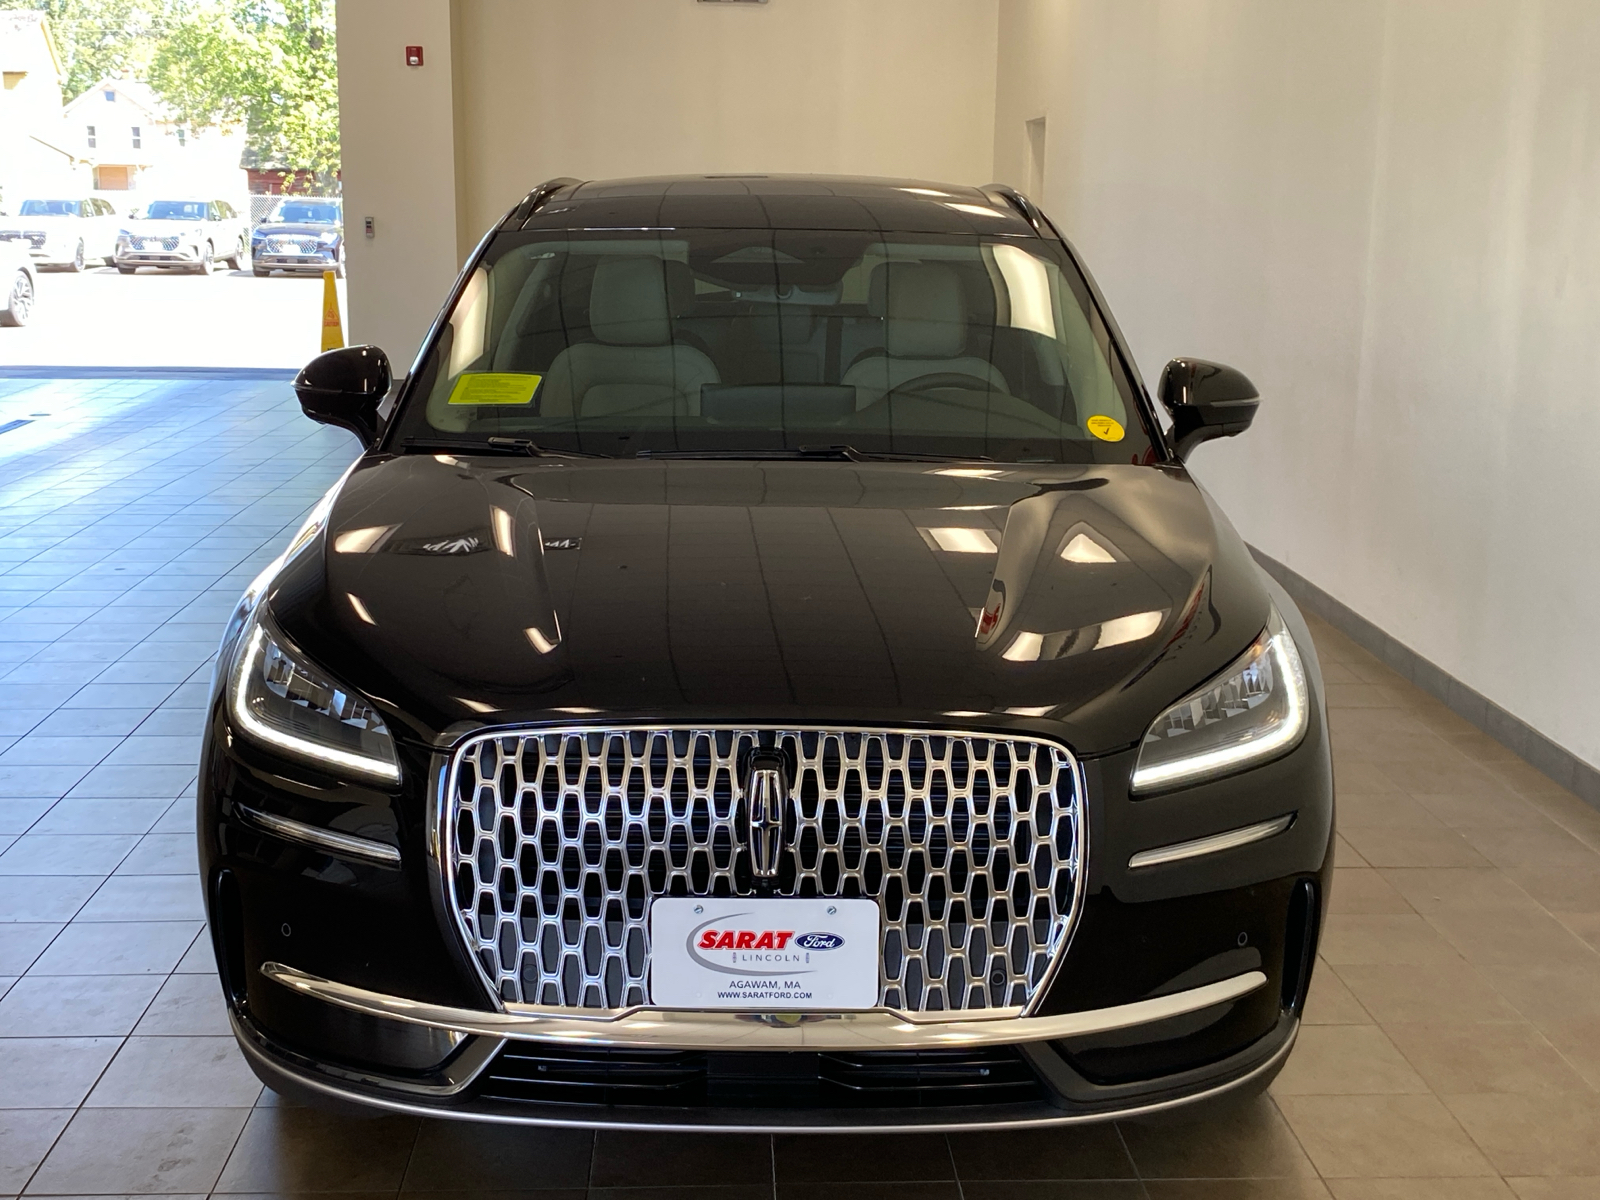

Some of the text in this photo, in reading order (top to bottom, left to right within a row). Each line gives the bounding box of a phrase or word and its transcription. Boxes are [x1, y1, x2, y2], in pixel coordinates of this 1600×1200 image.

[698, 929, 836, 950] SARAT Ford
[742, 954, 800, 962] LINCOLN
[729, 980, 801, 990] AGAWAM, MA
[717, 991, 812, 999] WWW.SARATFORD.COM
